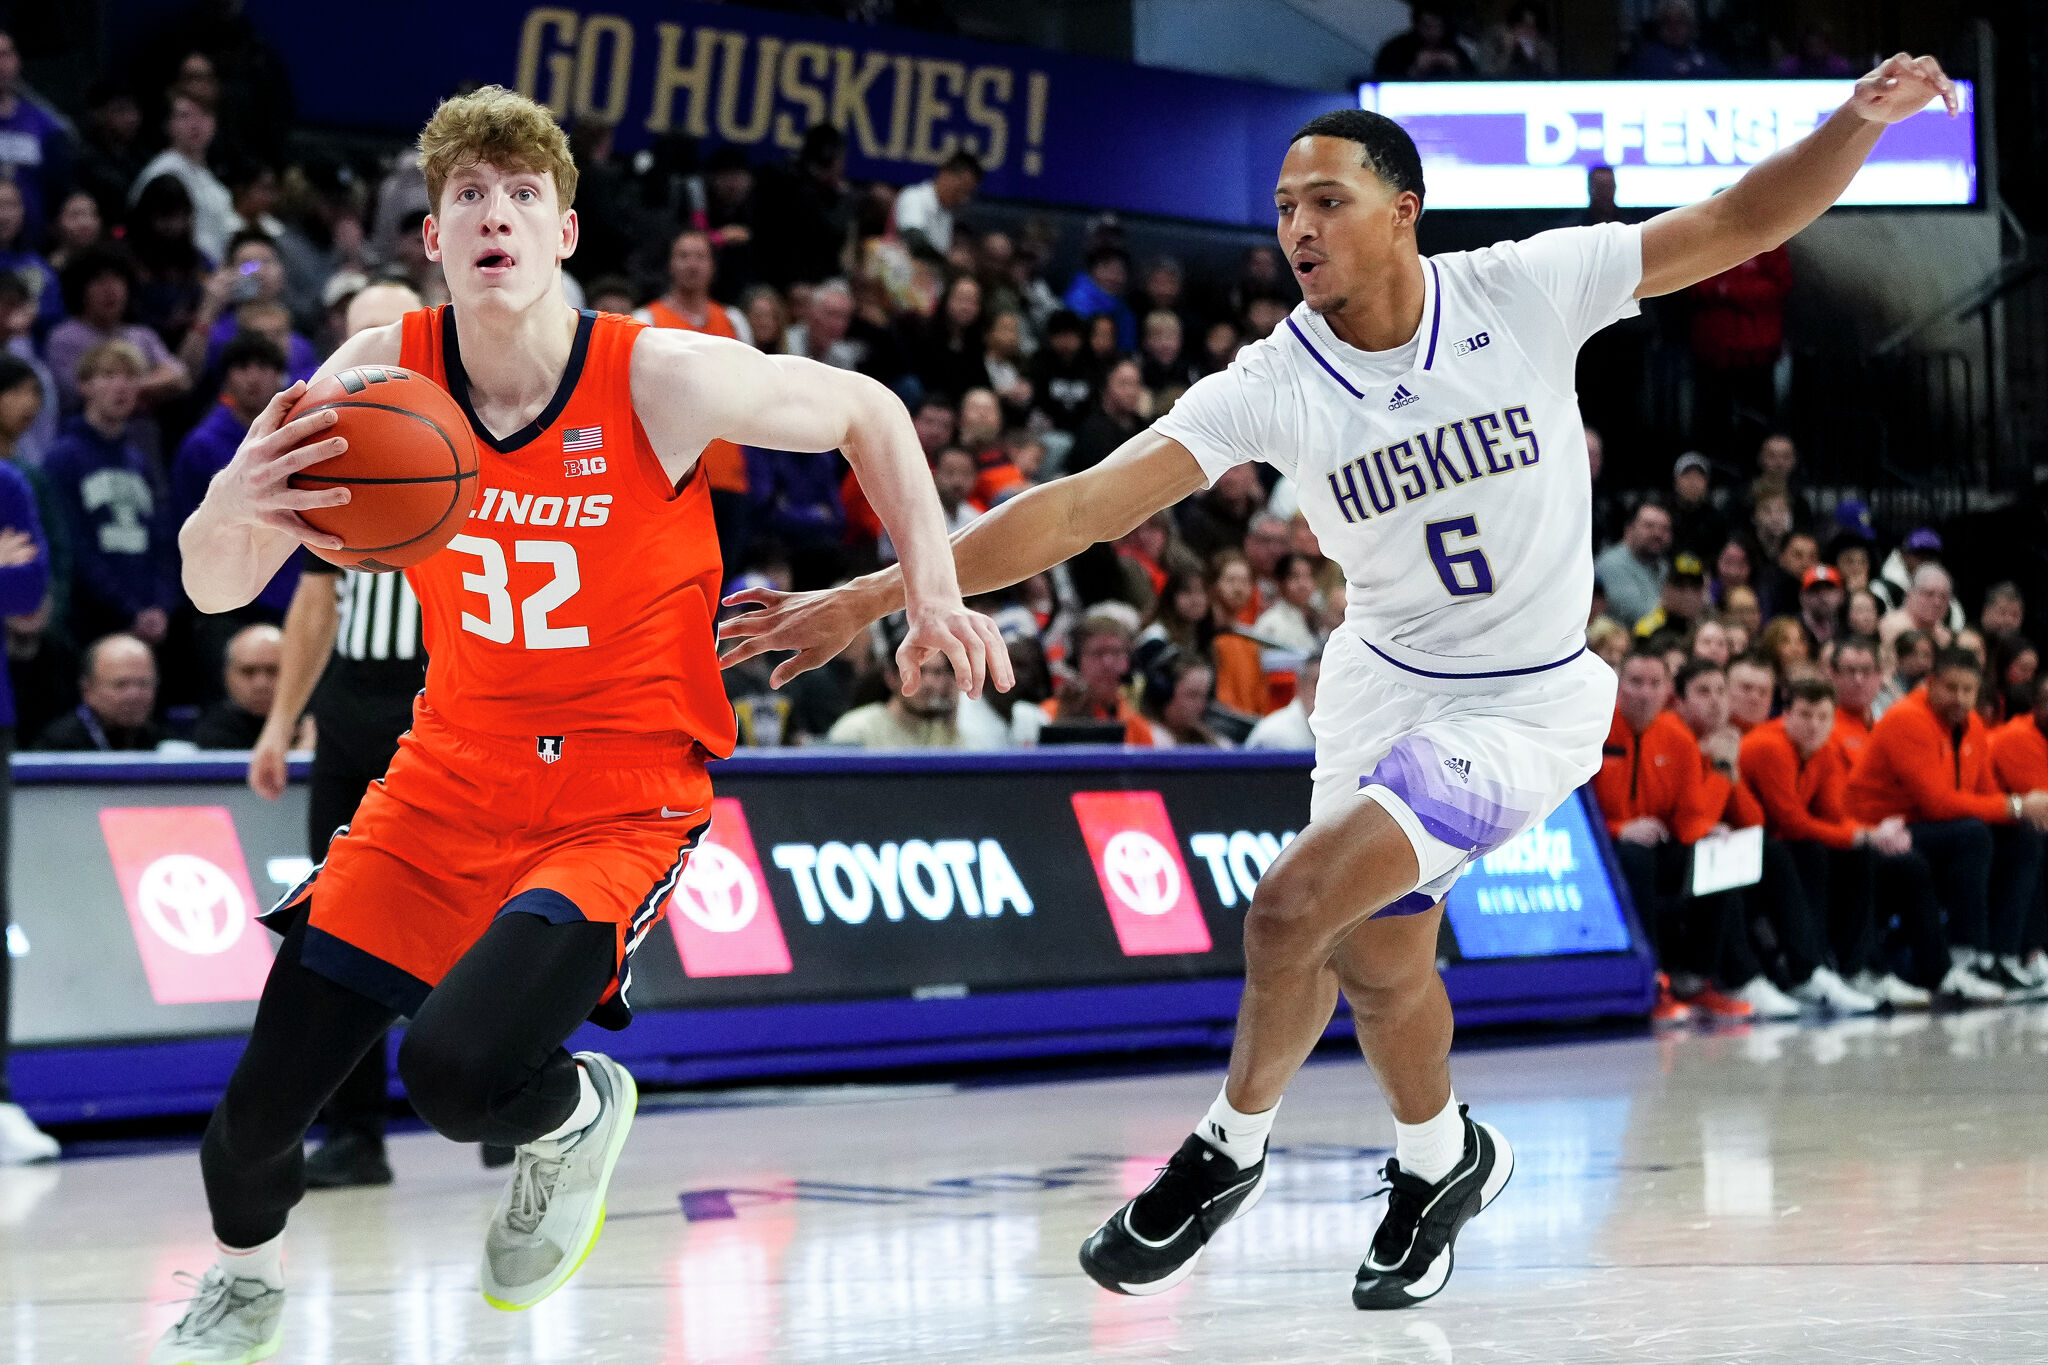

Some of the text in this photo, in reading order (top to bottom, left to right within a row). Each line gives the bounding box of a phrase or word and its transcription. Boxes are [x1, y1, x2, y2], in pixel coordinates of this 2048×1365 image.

[514, 7, 634, 127] GO
[1388, 395, 1420, 411] adidas
[1327, 404, 1540, 524] HUSKIES
[468, 487, 613, 528] INOIS
[446, 533, 590, 650] 32
[1424, 513, 1496, 597] 6
[1443, 759, 1469, 784] adidas
[773, 838, 1034, 925] TOYOTA
